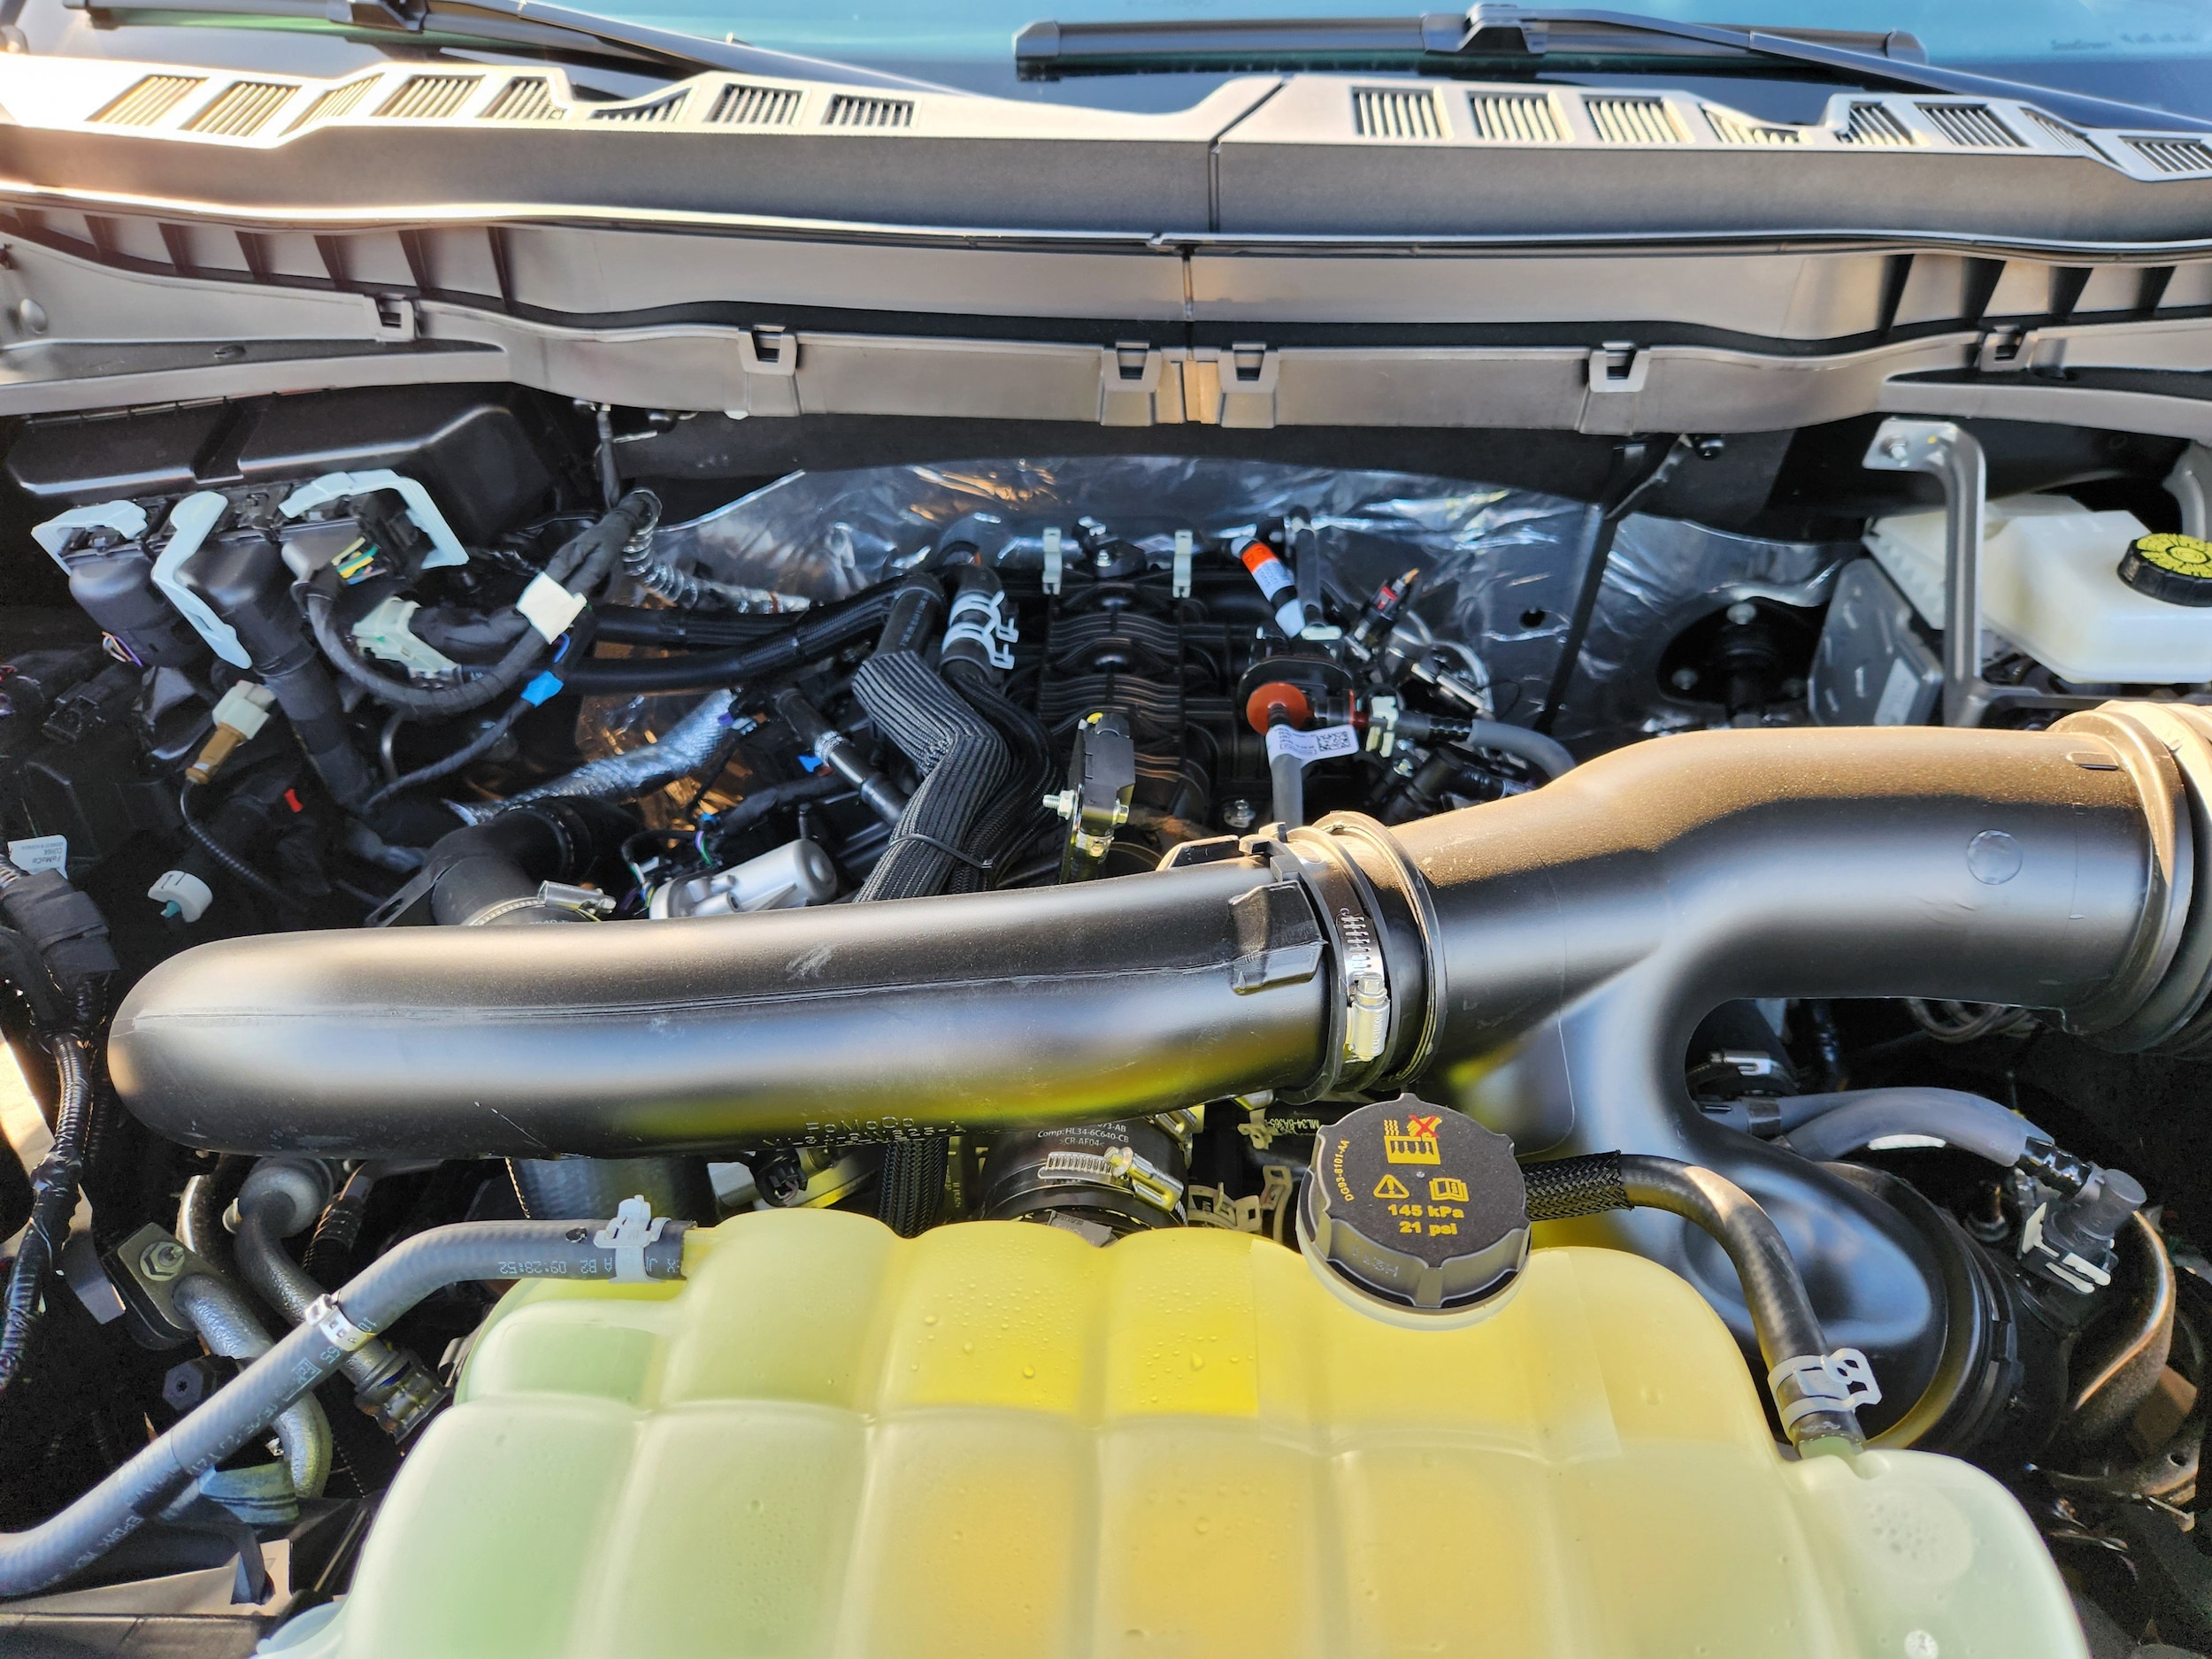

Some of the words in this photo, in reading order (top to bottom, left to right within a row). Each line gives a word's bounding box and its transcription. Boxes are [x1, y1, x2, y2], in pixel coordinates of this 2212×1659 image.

[1333, 1139, 1356, 1202] DG93-8101-AA
[1387, 1203, 1424, 1217] 145
[1427, 1204, 1465, 1218] kPa
[1398, 1220, 1423, 1233] 21
[1429, 1222, 1458, 1236] psi
[497, 1258, 568, 1275] 09:28:52
